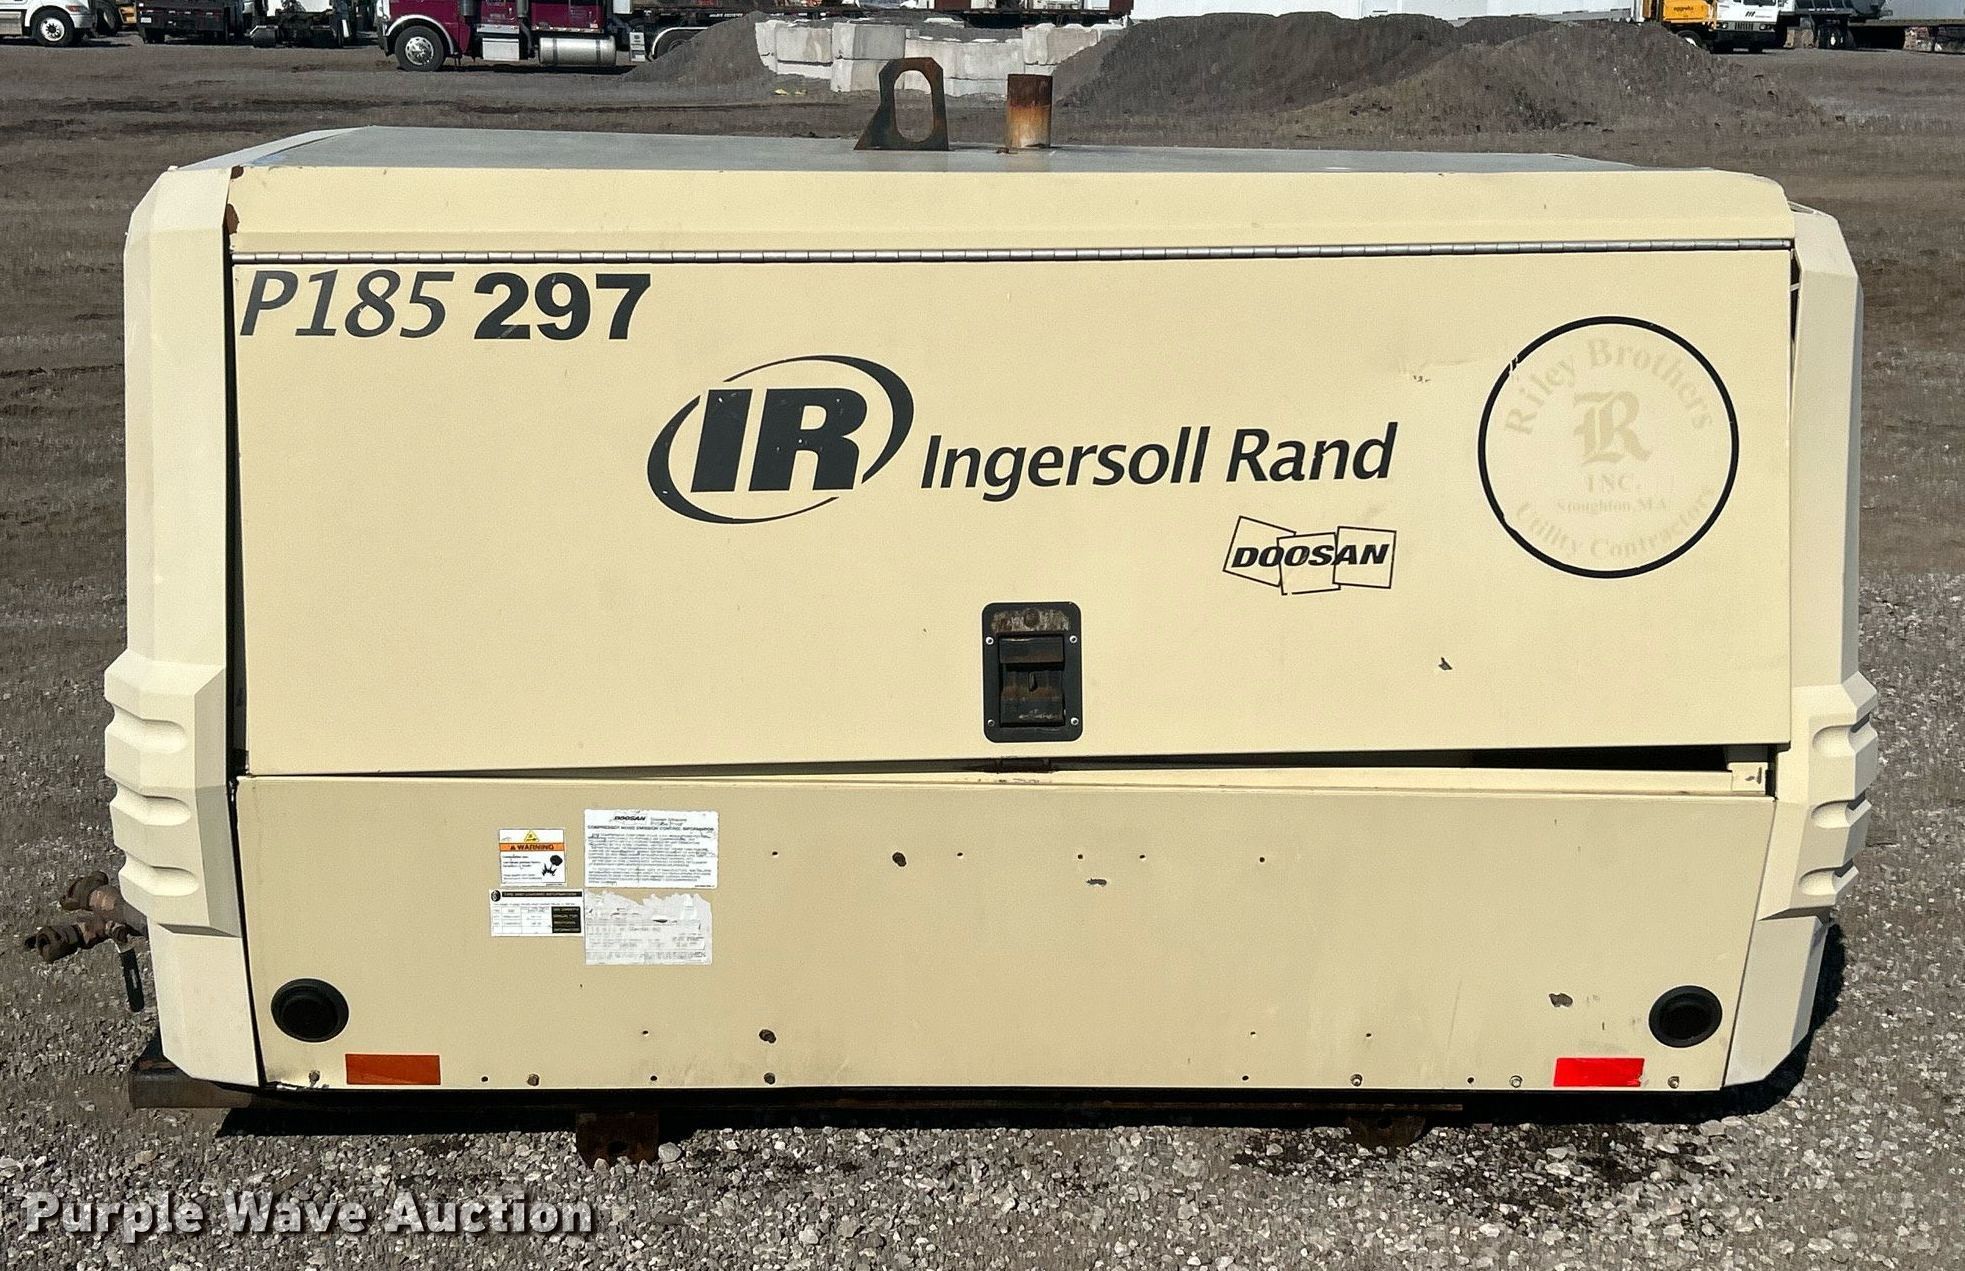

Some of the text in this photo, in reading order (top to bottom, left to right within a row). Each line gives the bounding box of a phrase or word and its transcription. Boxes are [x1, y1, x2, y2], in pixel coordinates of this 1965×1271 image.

[239, 269, 652, 340] P185 297
[1504, 337, 1714, 436] Riley Brothers
[690, 387, 868, 492] IR
[921, 421, 1399, 502] Ingersoll Rand
[1231, 542, 1389, 570] DOOSAN
